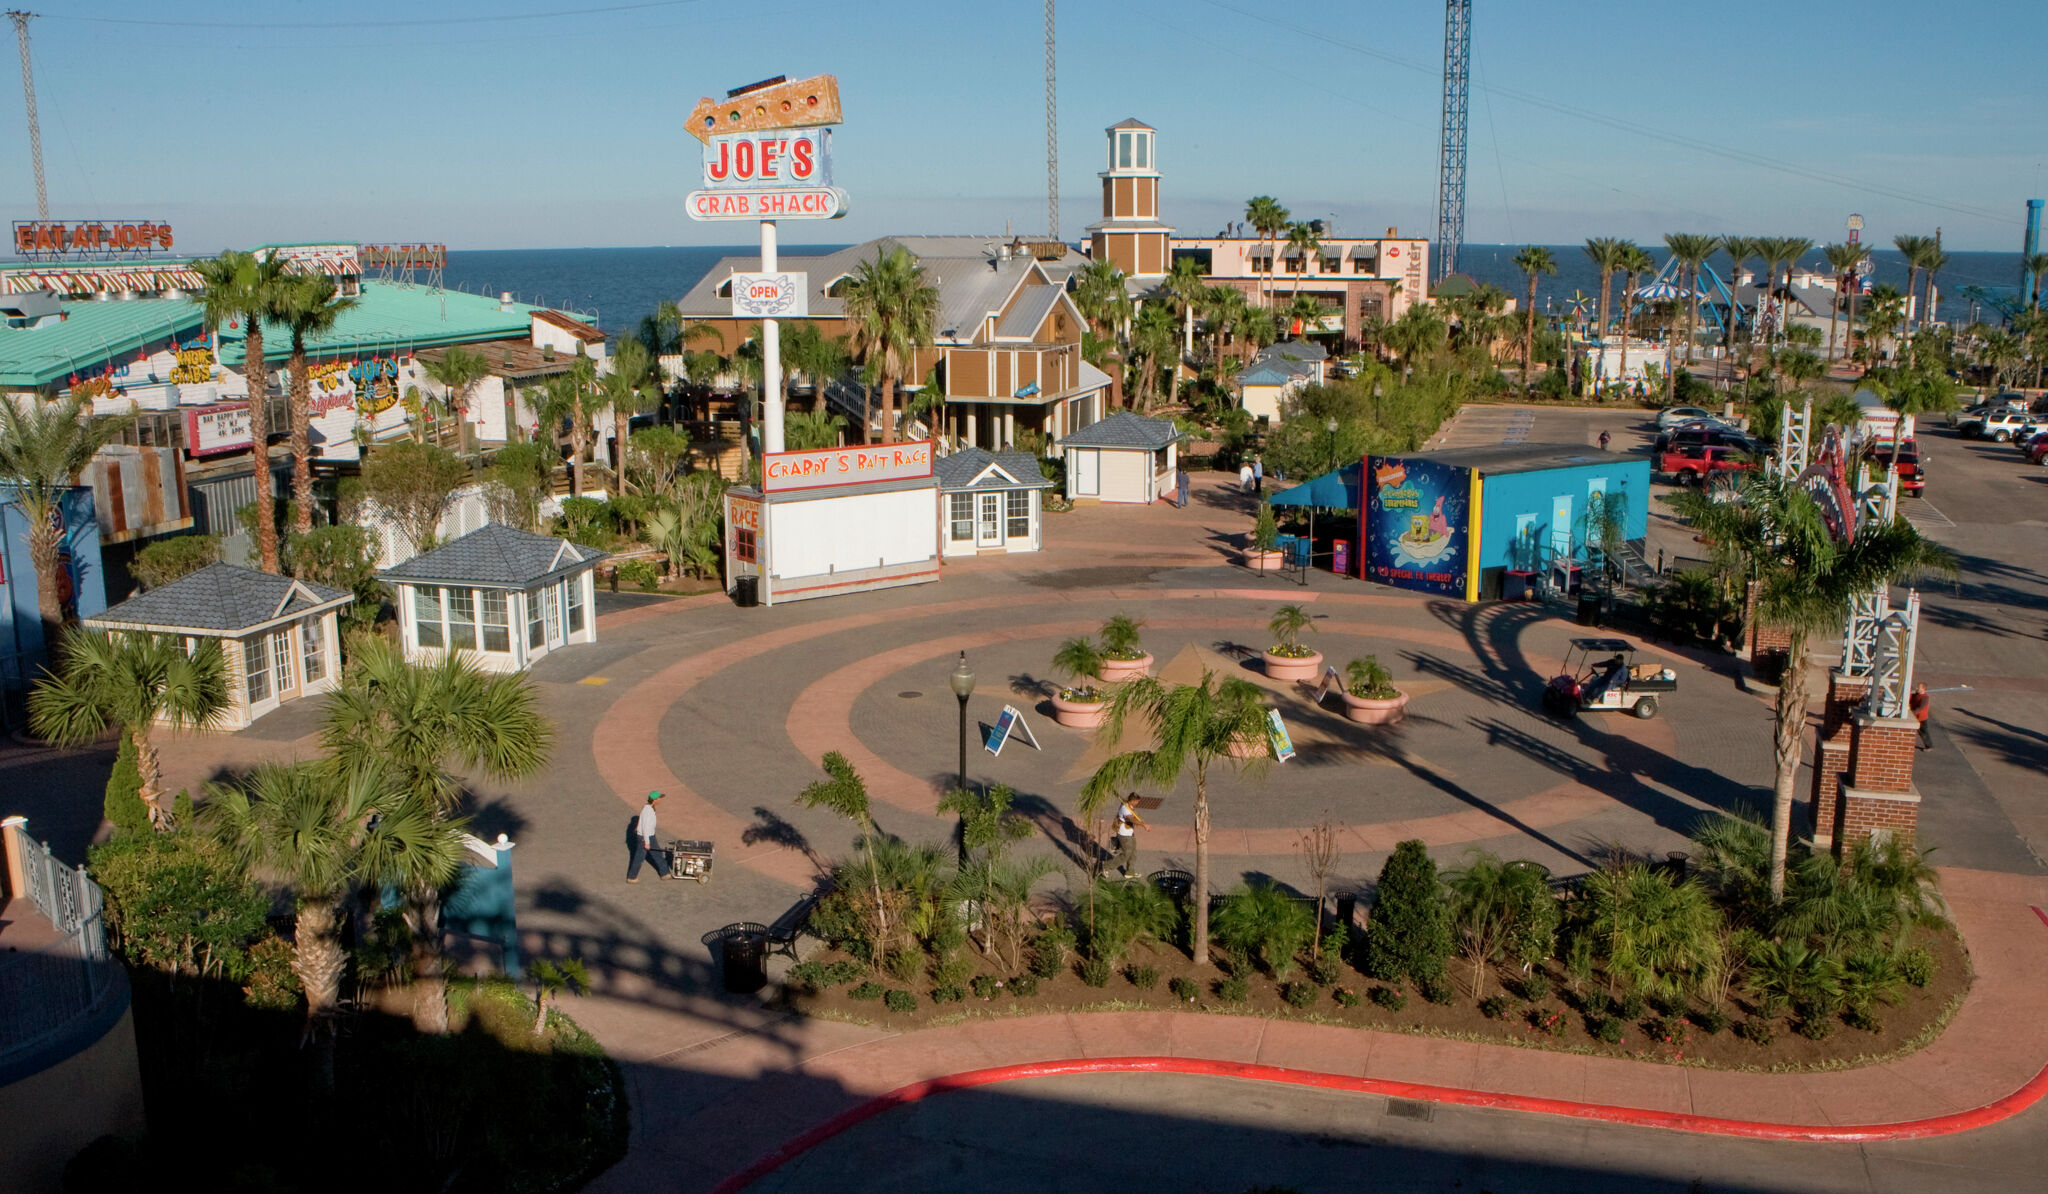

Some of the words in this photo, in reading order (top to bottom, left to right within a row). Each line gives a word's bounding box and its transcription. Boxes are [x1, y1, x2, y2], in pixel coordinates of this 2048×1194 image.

[709, 138, 814, 181] JOE'S
[697, 197, 750, 213] CRAB
[759, 194, 829, 213] SHACK
[17, 225, 66, 250] EAT
[73, 225, 102, 249] AT
[107, 224, 173, 248] JOE'S
[750, 286, 778, 299] OPEN
[169, 365, 211, 384] CRABS
[320, 373, 338, 392] TO
[857, 453, 889, 471] BAIT
[893, 449, 928, 468] RACE
[731, 506, 759, 528] RACE
